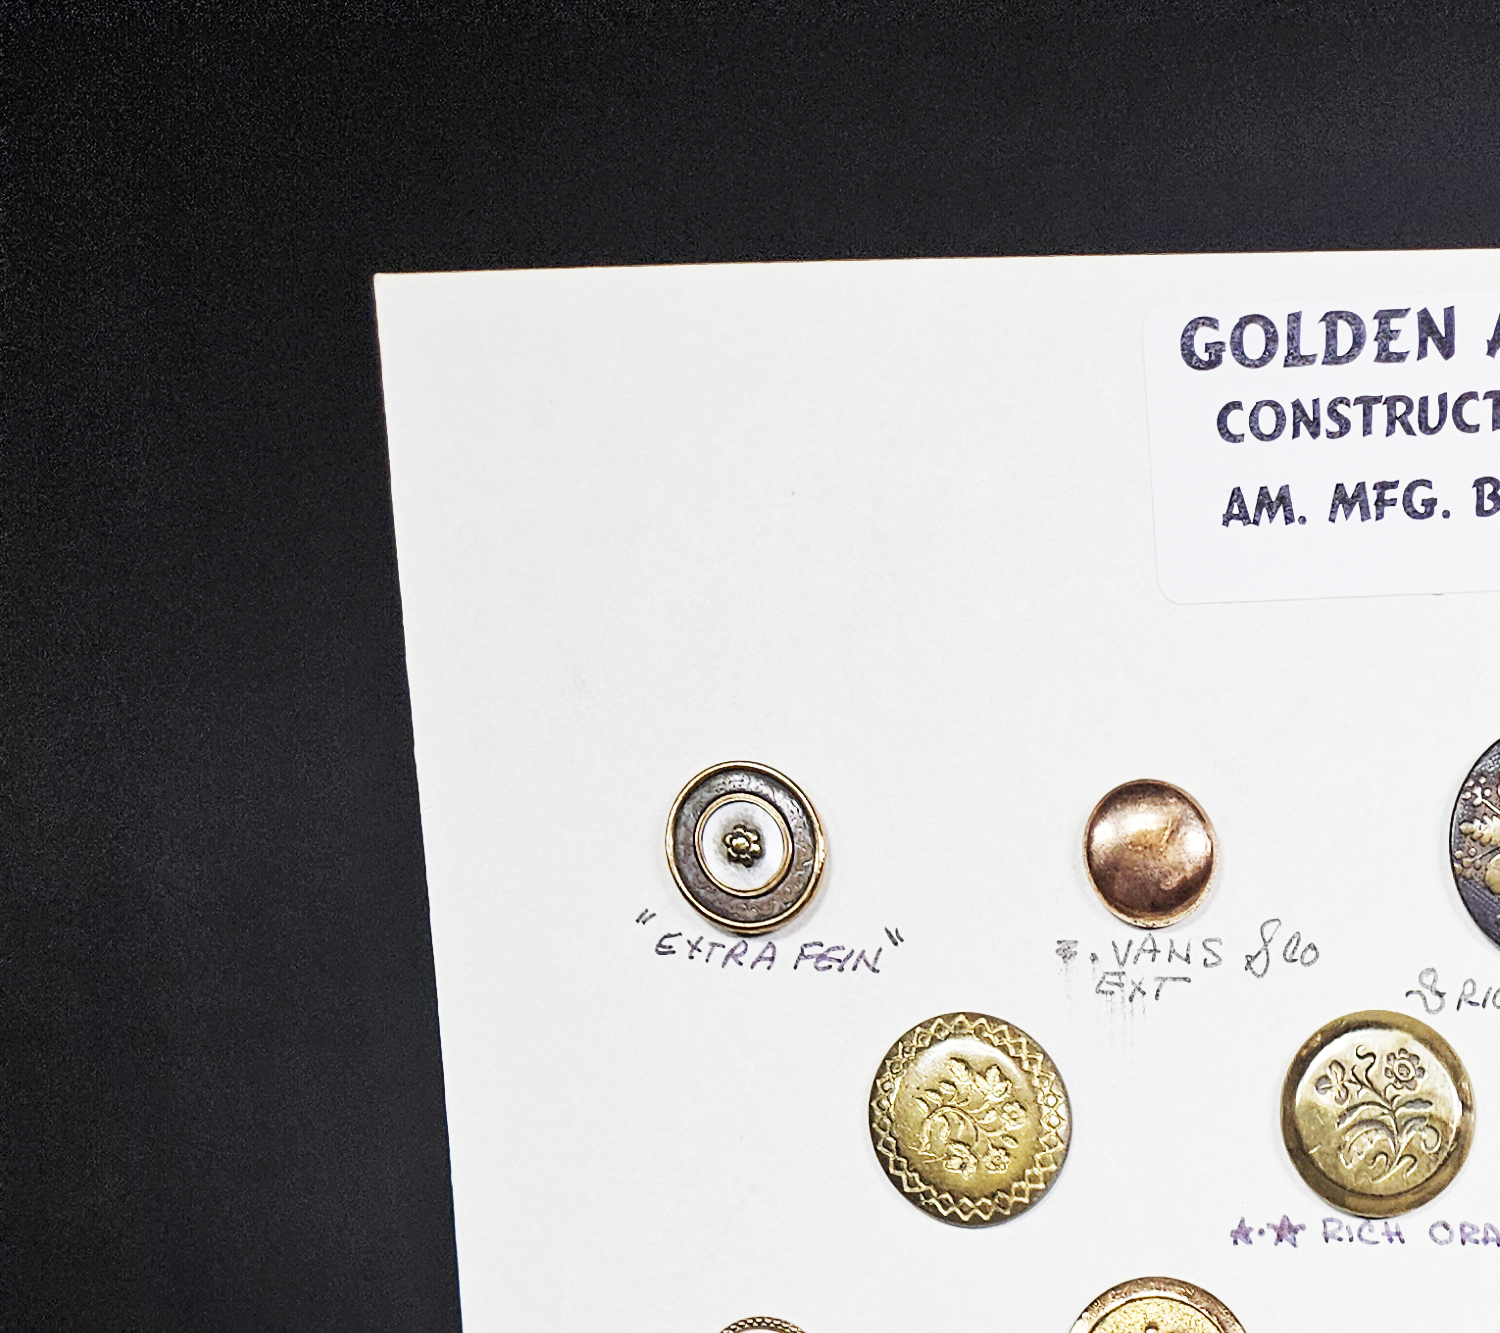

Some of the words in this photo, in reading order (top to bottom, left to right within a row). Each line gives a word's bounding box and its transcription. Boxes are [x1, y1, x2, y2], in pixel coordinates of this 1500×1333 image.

[1180, 305, 1456, 371] GOLDEN
[1221, 484, 1307, 528] AM.
[1328, 478, 1451, 524] MFG.
[1095, 970, 1192, 1003] EXT
[1320, 1217, 1406, 1248] RICH
